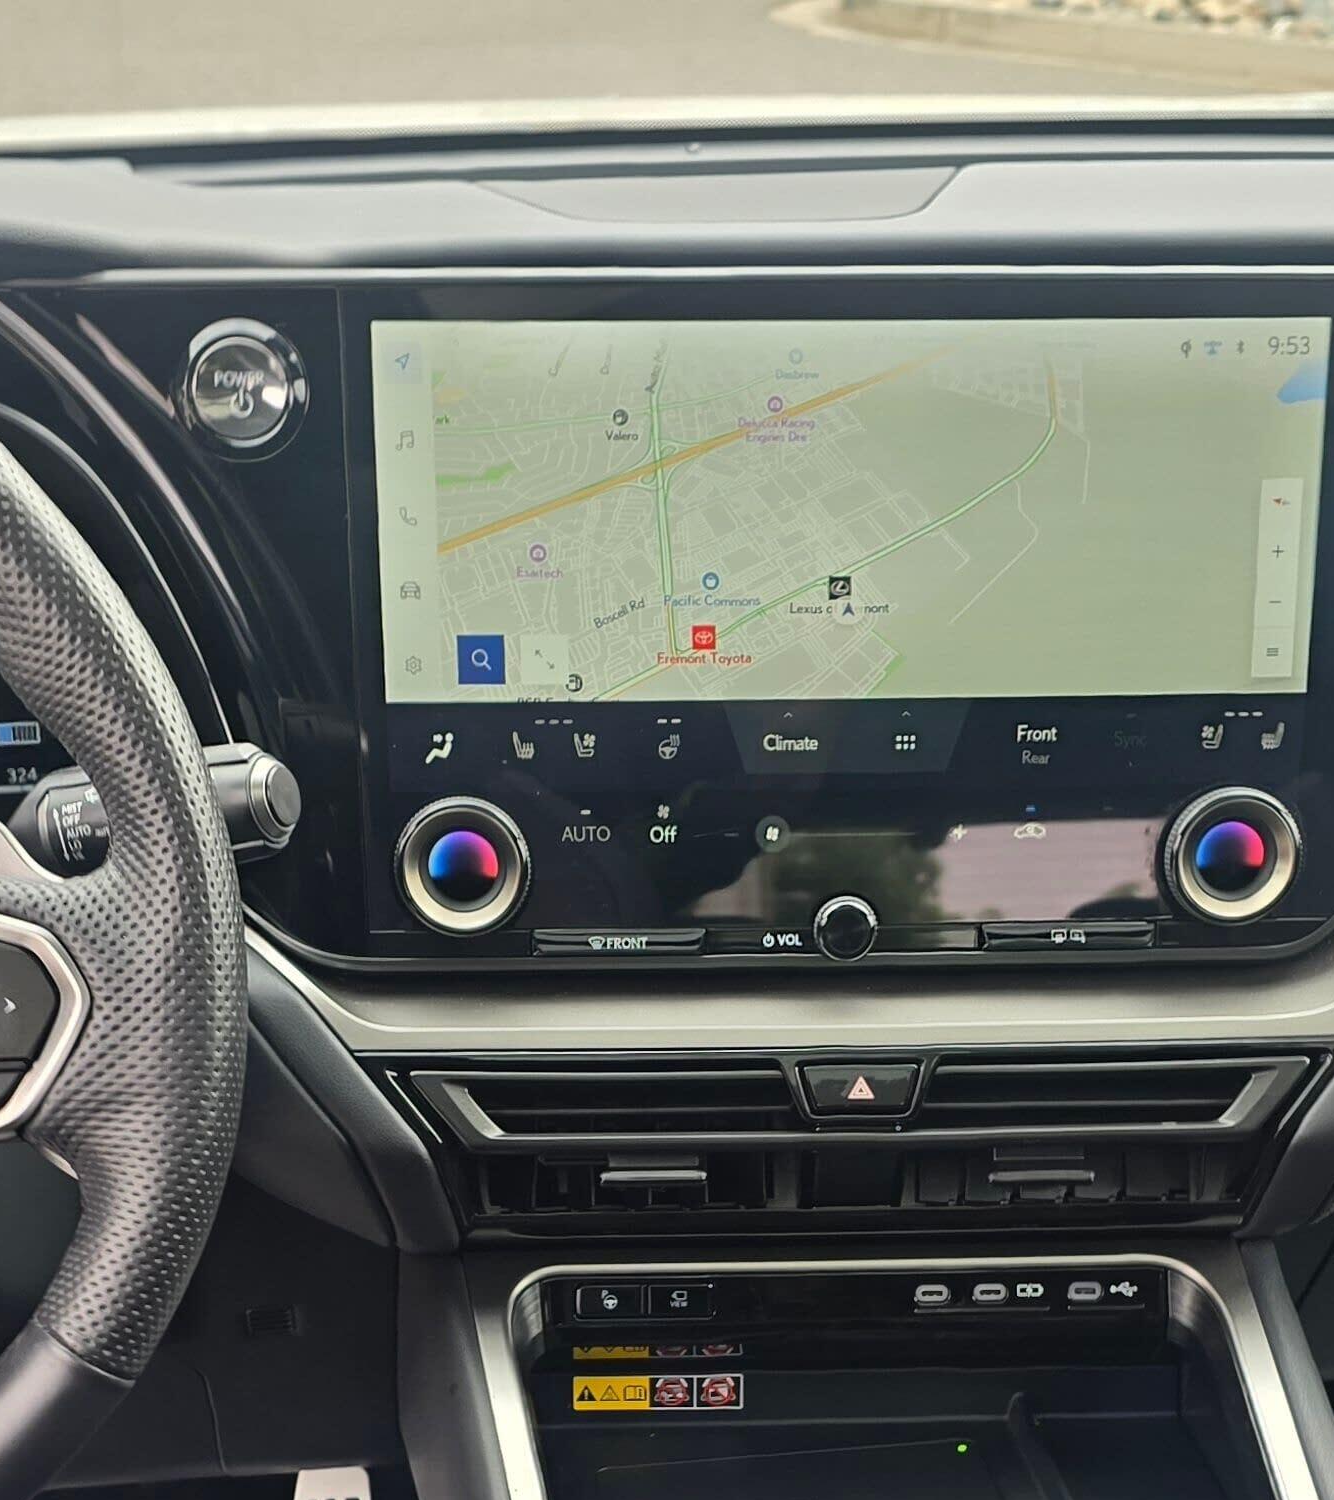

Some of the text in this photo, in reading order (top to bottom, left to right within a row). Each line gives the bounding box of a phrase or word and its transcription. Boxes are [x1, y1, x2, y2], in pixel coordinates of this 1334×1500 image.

[1268, 335, 1310, 356] 9:53
[213, 369, 266, 388] POWER
[781, 416, 815, 431] Racing
[605, 429, 639, 443] Valero
[663, 594, 761, 607] Pacific Commons
[789, 602, 823, 614] Lexus
[593, 597, 646, 630] Boscell Rd
[709, 652, 753, 667] Toyota
[1016, 725, 1058, 744] Front
[1113, 730, 1147, 750] Sync
[762, 734, 819, 753] Climate
[1021, 750, 1051, 766] Rear
[6, 766, 38, 785] 324
[61, 801, 83, 815] MIST
[62, 813, 81, 828] OFF
[67, 824, 92, 841] AUTO
[561, 825, 612, 844] AUTO
[649, 825, 678, 845] Off
[605, 935, 649, 951] FRONT
[777, 933, 804, 948] VOL
